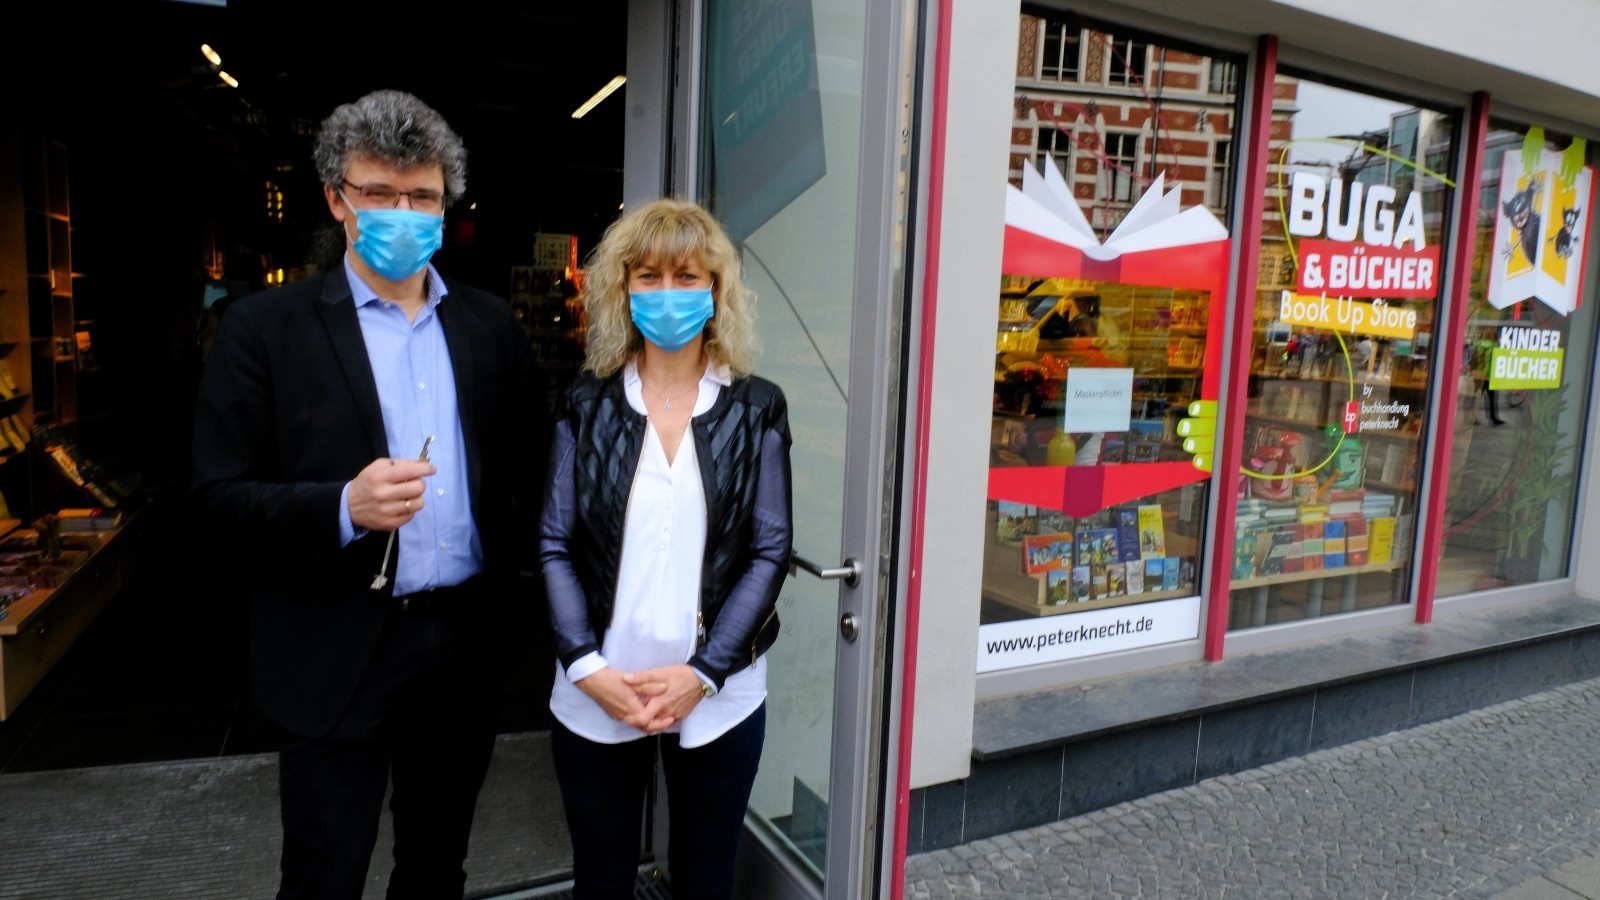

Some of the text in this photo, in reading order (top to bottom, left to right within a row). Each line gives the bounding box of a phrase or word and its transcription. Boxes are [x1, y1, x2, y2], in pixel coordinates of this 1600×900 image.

[1289, 171, 1426, 252] BUGA
[1303, 246, 1434, 291] & BÜCHER
[1280, 289, 1417, 334] Book Up Store
[1500, 326, 1561, 353] KINDER
[1494, 350, 1559, 381] BÜCHER
[1361, 381, 1374, 399] by
[1361, 399, 1410, 417] buchhandlung
[1358, 415, 1399, 433] peterknecht
[986, 616, 1154, 656] www.peterknecht.de
